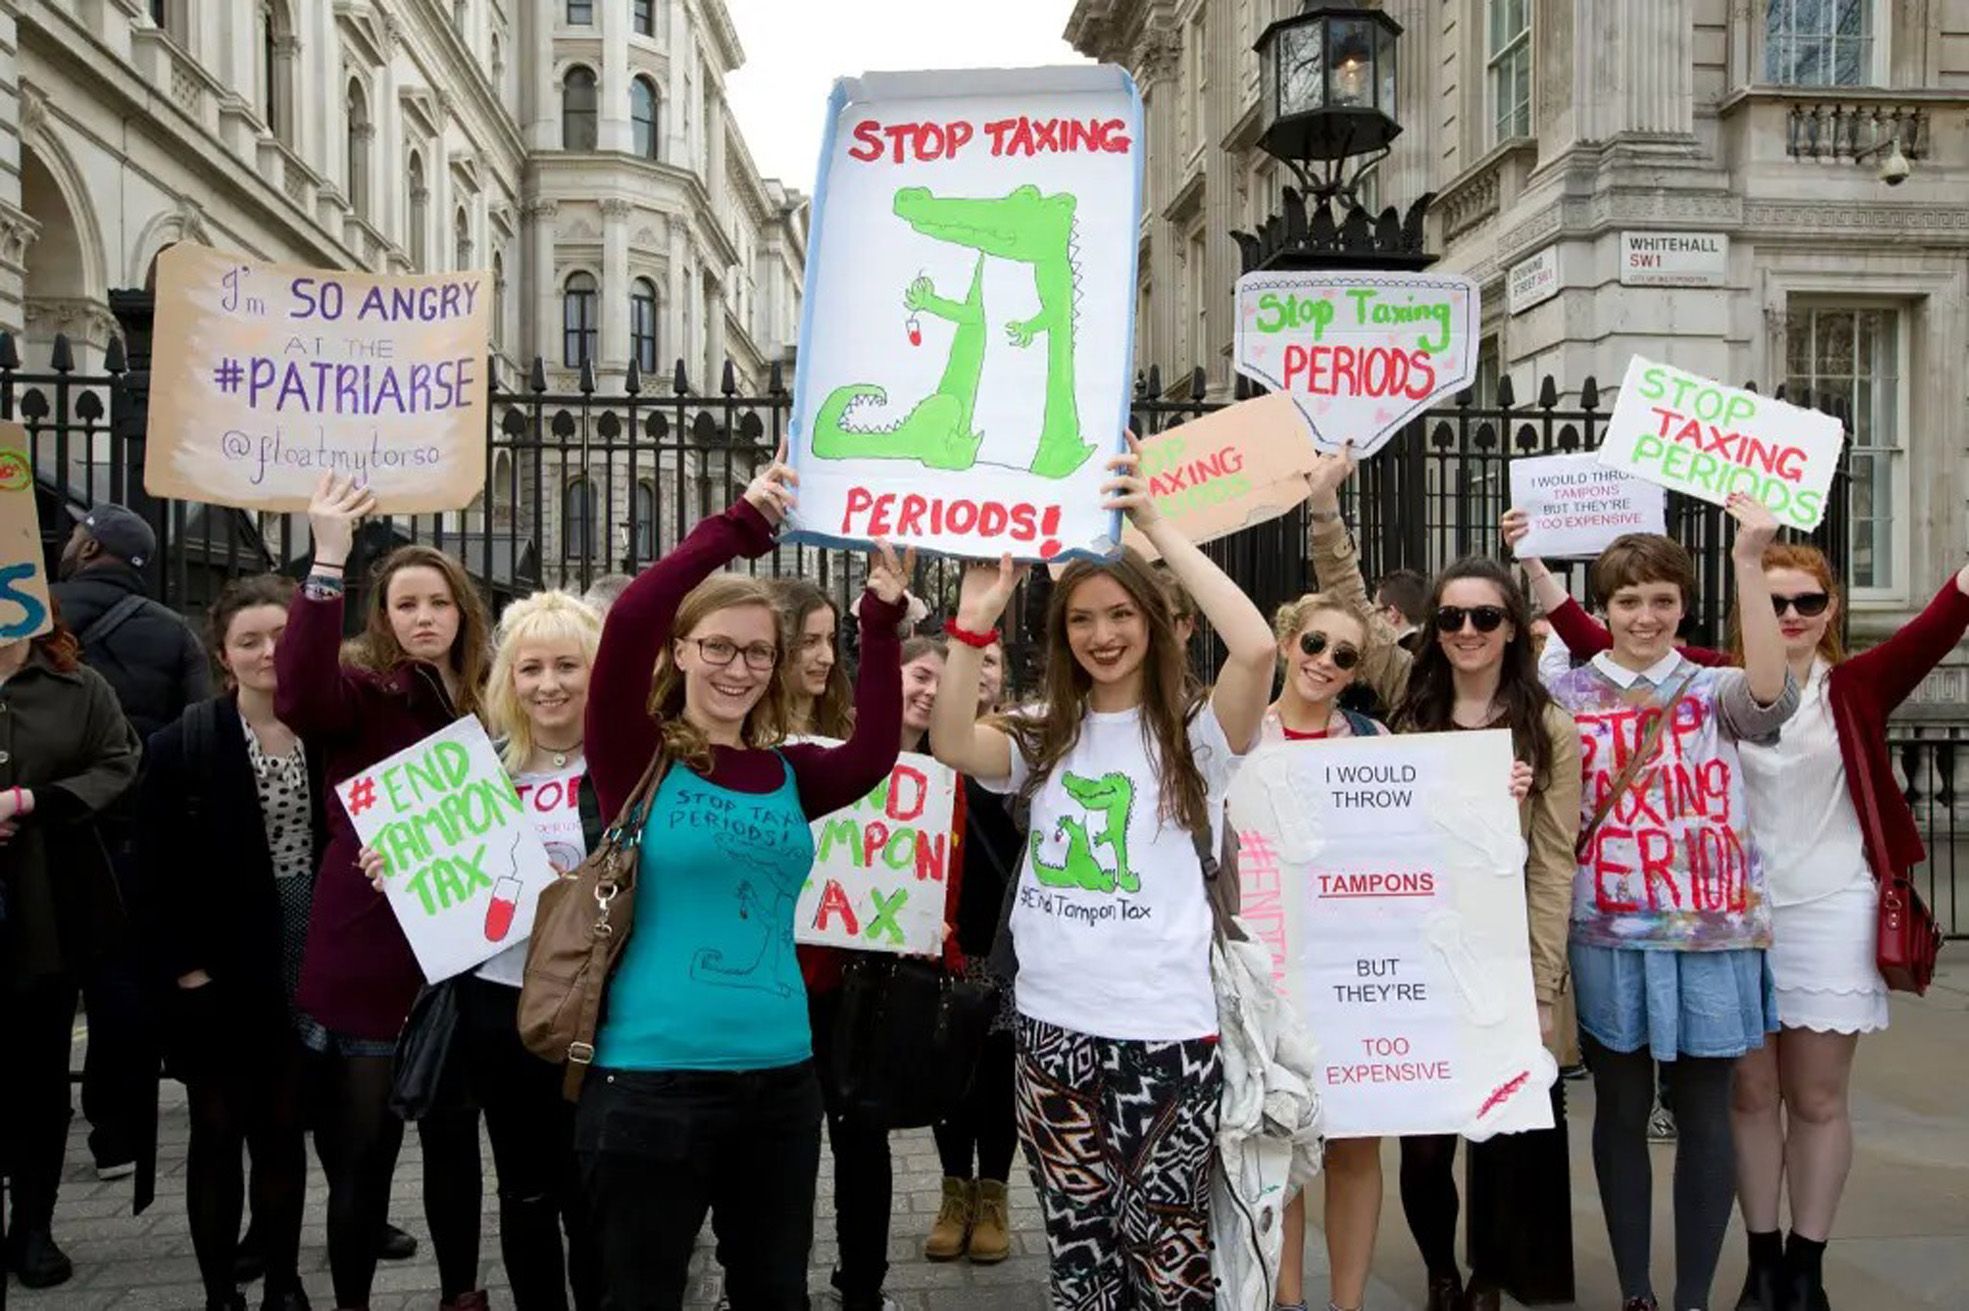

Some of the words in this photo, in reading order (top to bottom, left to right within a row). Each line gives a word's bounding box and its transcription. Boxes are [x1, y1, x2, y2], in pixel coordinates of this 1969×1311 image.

[849, 120, 972, 163] STOP
[984, 116, 1131, 157] TAXING
[1629, 237, 1719, 253] WHITEHALL
[1630, 254, 1661, 268] SW1
[221, 266, 265, 316] I'm
[290, 278, 344, 320] SO
[357, 280, 480, 322] ANGRY
[1256, 293, 1334, 341] Stop
[1346, 288, 1450, 353] Taxing
[284, 336, 325, 356] AT
[348, 339, 394, 359] THE
[214, 357, 475, 415] #PATRIARSE
[1283, 345, 1436, 401] PERIODS
[1639, 368, 1756, 427] STOP
[1652, 406, 1808, 483] TAXING
[1149, 446, 1243, 498] AXING
[1537, 473, 1588, 488] WOULD
[1591, 470, 1635, 483] THRO
[1553, 484, 1620, 500] TAMPONS
[1631, 434, 1823, 526] PERIODS
[841, 486, 1062, 559] PERIODS!
[1543, 503, 1568, 516] BUT
[1574, 498, 1631, 513] THEY'RE
[1565, 512, 1642, 529] EXPENSIVE
[348, 740, 470, 816] #END
[1325, 766, 1330, 784] I
[1337, 765, 1416, 784] WOULD
[676, 789, 736, 812] STOP
[1332, 789, 1412, 808] THROW
[370, 778, 524, 878] TAMPON
[817, 818, 945, 882] MPON
[405, 844, 493, 916] TAX
[1318, 873, 1434, 894] TAMPONS
[1577, 824, 1748, 915] ERIOD
[805, 879, 908, 945] AX
[1357, 958, 1399, 977] BUT
[1333, 983, 1426, 1003] THEY'RE
[1362, 1037, 1410, 1057] TOO
[1326, 1061, 1452, 1086] EXPENSIVE
